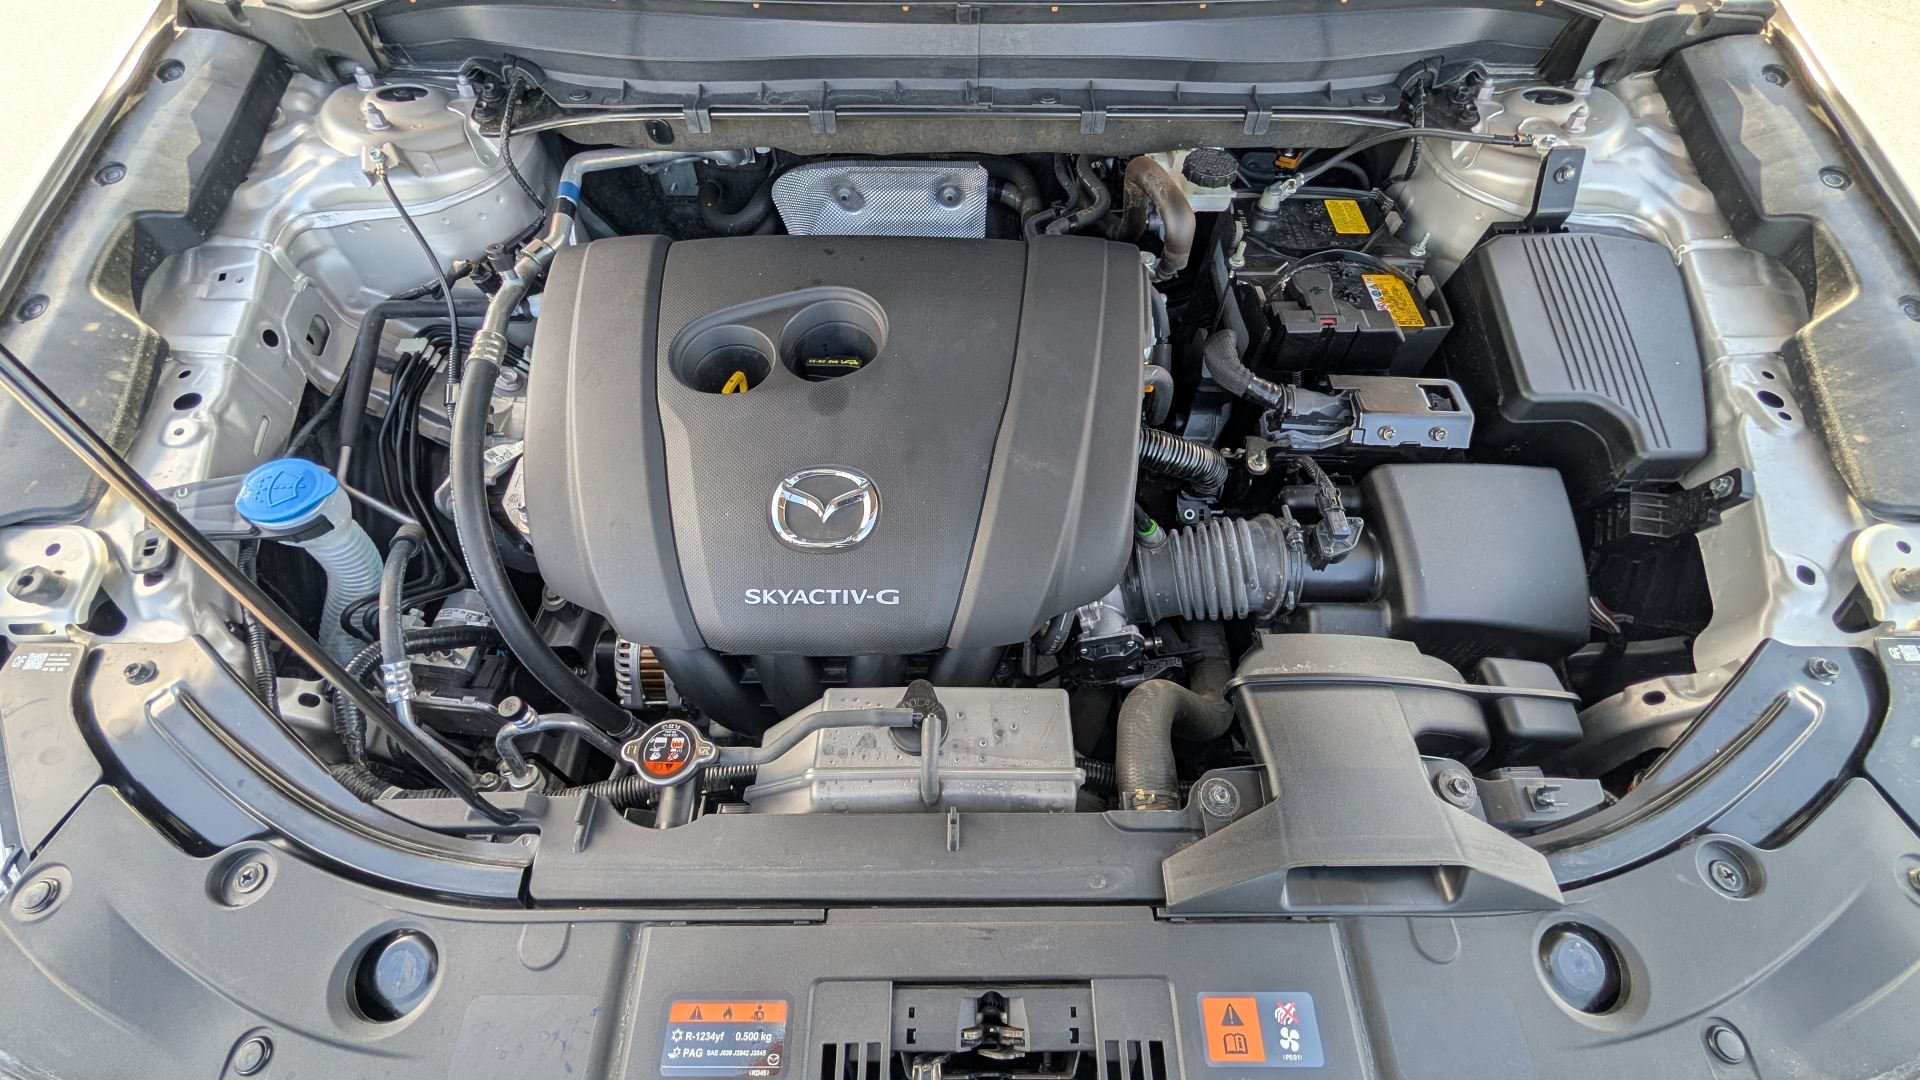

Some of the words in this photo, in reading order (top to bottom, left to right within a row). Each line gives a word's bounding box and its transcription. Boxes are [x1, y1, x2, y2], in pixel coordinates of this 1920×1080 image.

[744, 588, 900, 605] SKYACTIV-G
[902, 696, 942, 714] OOLANT
[685, 1031, 725, 1043] R-1234yf
[735, 1031, 759, 1041] 0.500
[760, 1031, 772, 1043] kg
[682, 1048, 703, 1058] PAG
